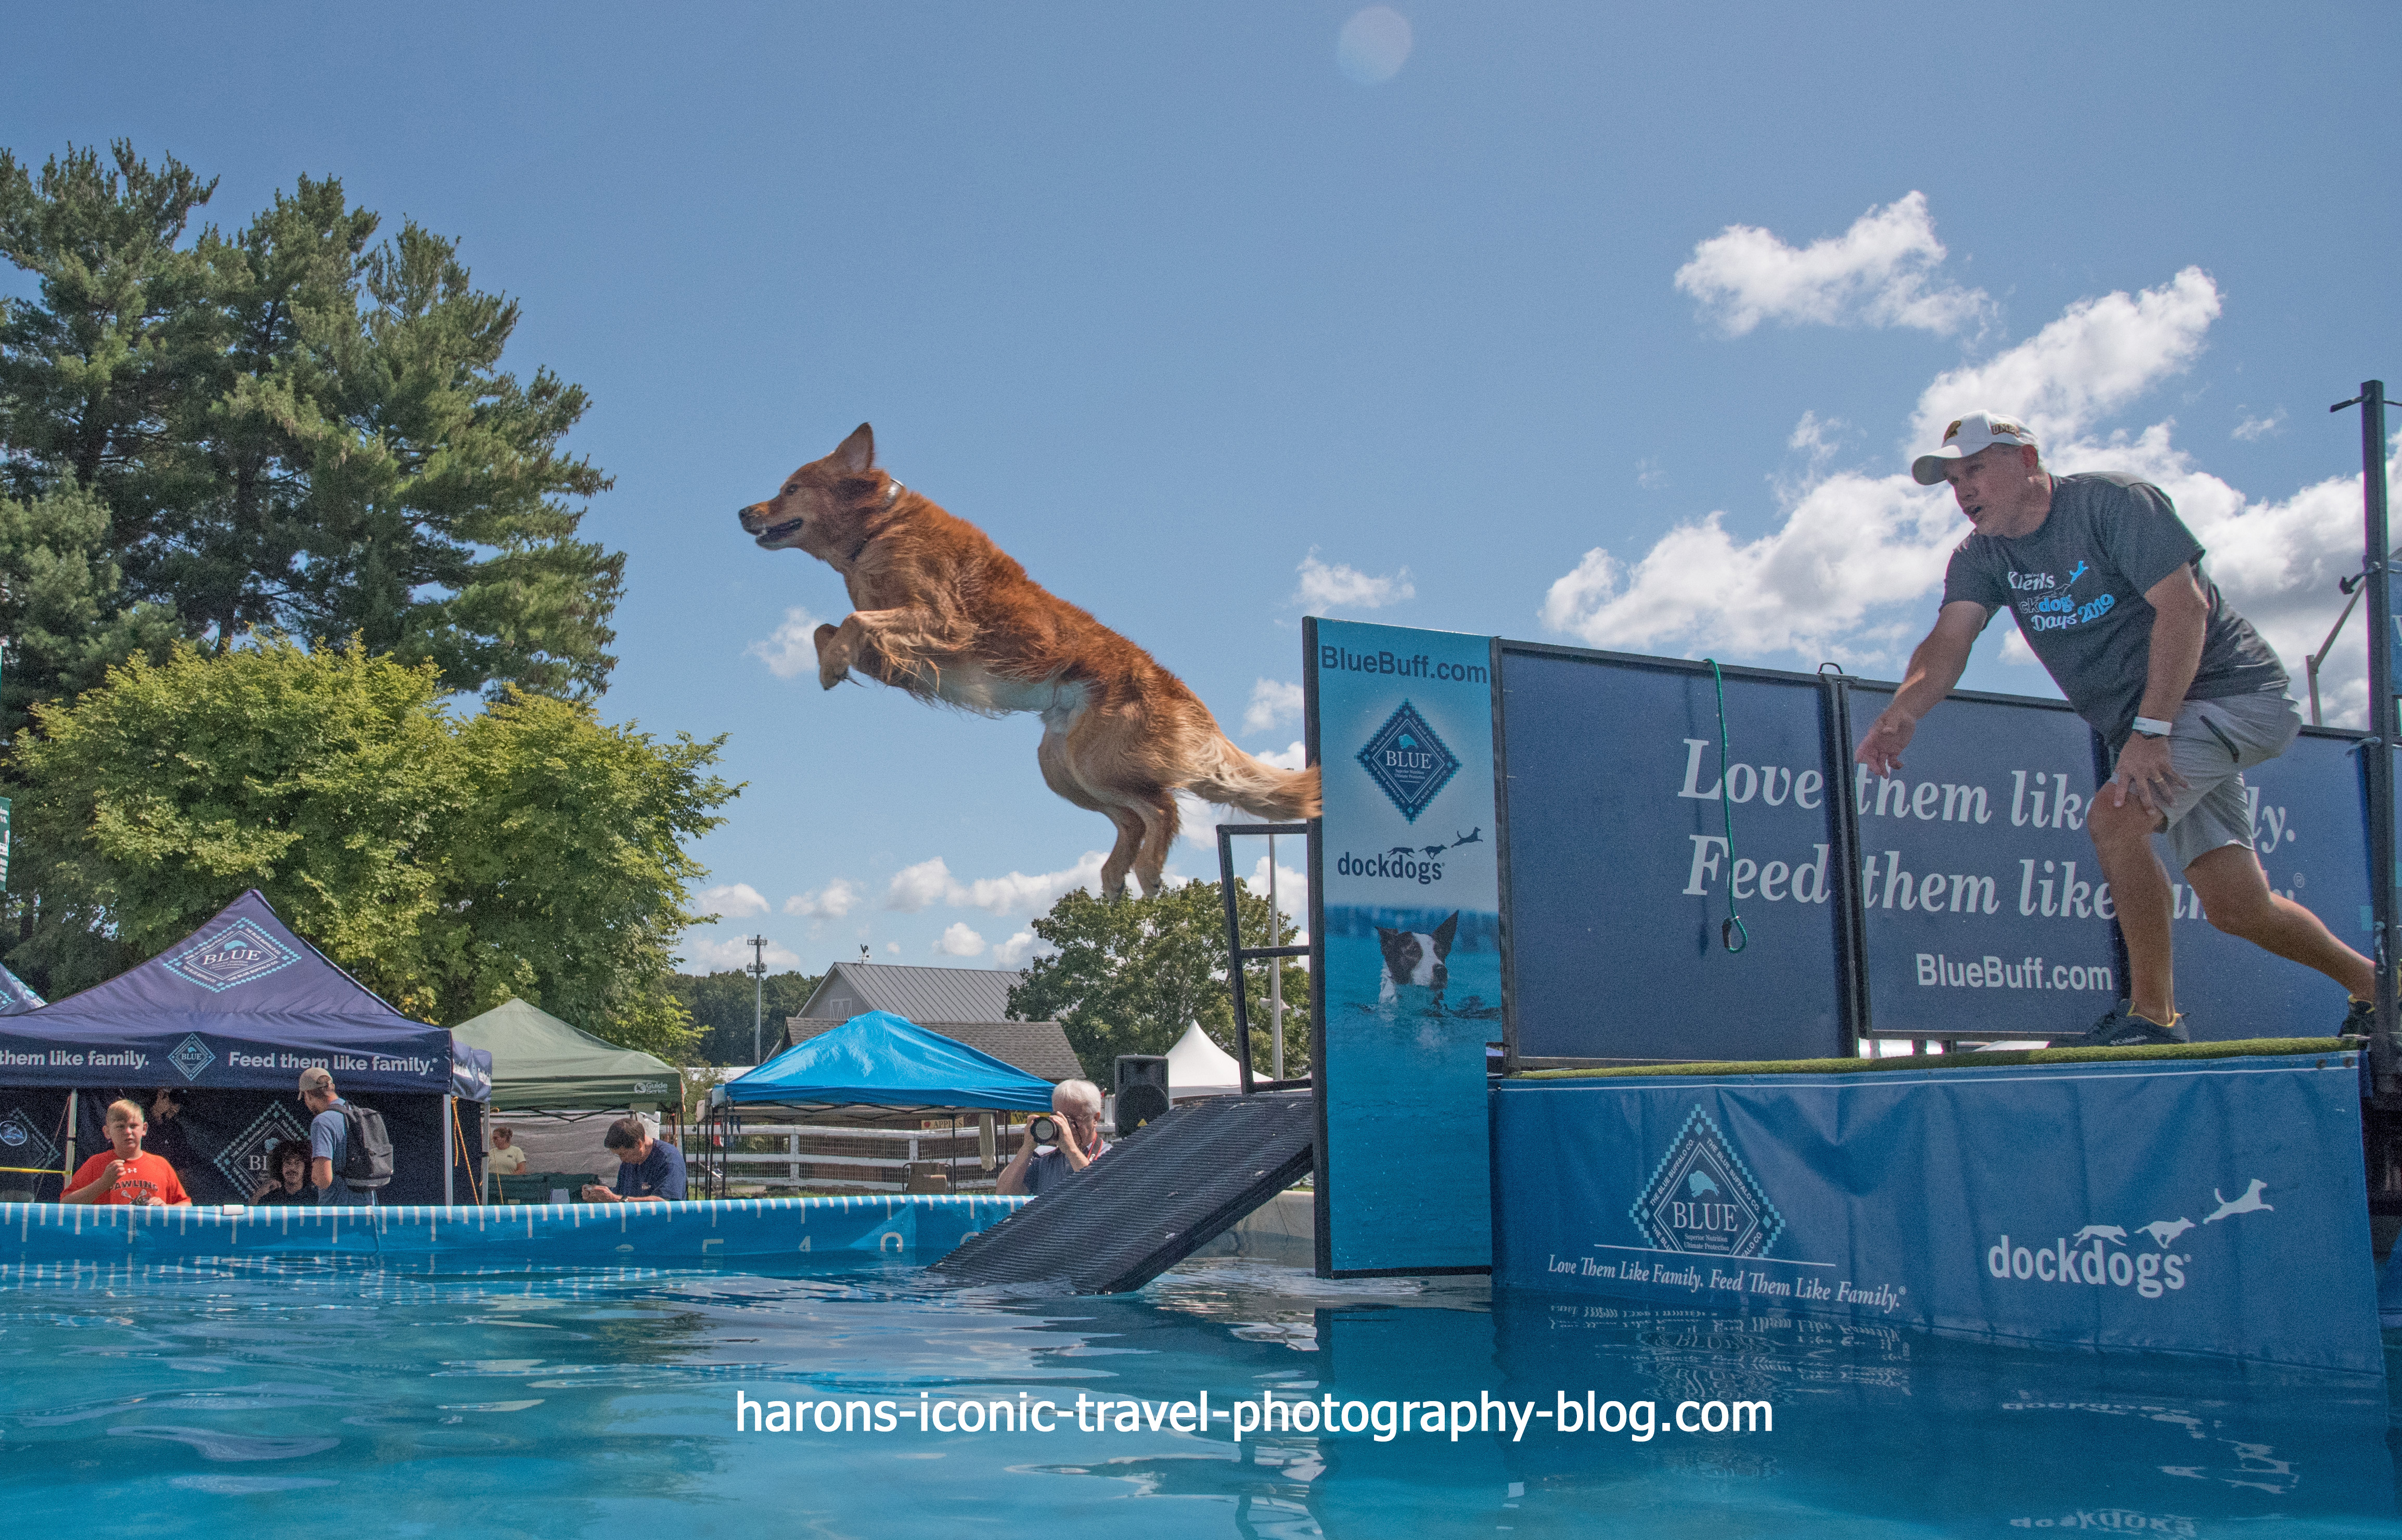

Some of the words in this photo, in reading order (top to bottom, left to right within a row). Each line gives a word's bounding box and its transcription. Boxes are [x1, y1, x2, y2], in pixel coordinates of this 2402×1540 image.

[2031, 613, 2077, 632] Days
[2078, 594, 2114, 623] 2019
[1320, 645, 1487, 684] BlueBuff.com
[1385, 750, 1432, 769] BLUE
[1677, 738, 1823, 809] Love
[1855, 762, 1992, 824] them
[2010, 770, 2095, 830] lik
[1337, 852, 1443, 884] dockdogs
[1682, 835, 1831, 904] Feed
[1862, 851, 2000, 915] them
[2019, 858, 2116, 919] like
[202, 949, 261, 965] BLUE
[1916, 953, 2113, 990] BlueBuff.com
[0, 1050, 45, 1066] them
[49, 1050, 84, 1066] like
[88, 1050, 149, 1070] family.
[229, 1051, 275, 1068] Feed
[280, 1053, 328, 1070] them
[333, 1055, 367, 1071] like
[934, 1120, 962, 1128] APPLS
[1650, 1192, 1660, 1206] THE
[1657, 1176, 1671, 1195] BLUE
[1668, 1149, 1687, 1178] BUFFALO
[1706, 1137, 1718, 1153] THE
[1717, 1151, 1731, 1171] BLUE
[1729, 1169, 1752, 1200] BUFFALO
[1652, 1223, 1662, 1239] THE
[1672, 1201, 1738, 1231] BLUE
[1685, 1233, 1704, 1241] Superior
[1705, 1234, 1728, 1242] Nutrition
[1705, 1243, 1730, 1251] Protection
[1548, 1253, 1576, 1274] Love
[1581, 1256, 1616, 1278] Them
[1619, 1261, 1650, 1281] Like
[1652, 1263, 1703, 1293] Family.
[1709, 1268, 1744, 1291] Feed
[1749, 1270, 1791, 1297] Them
[1795, 1277, 1831, 1300] Like
[1988, 1235, 2186, 1298] dockdogs
